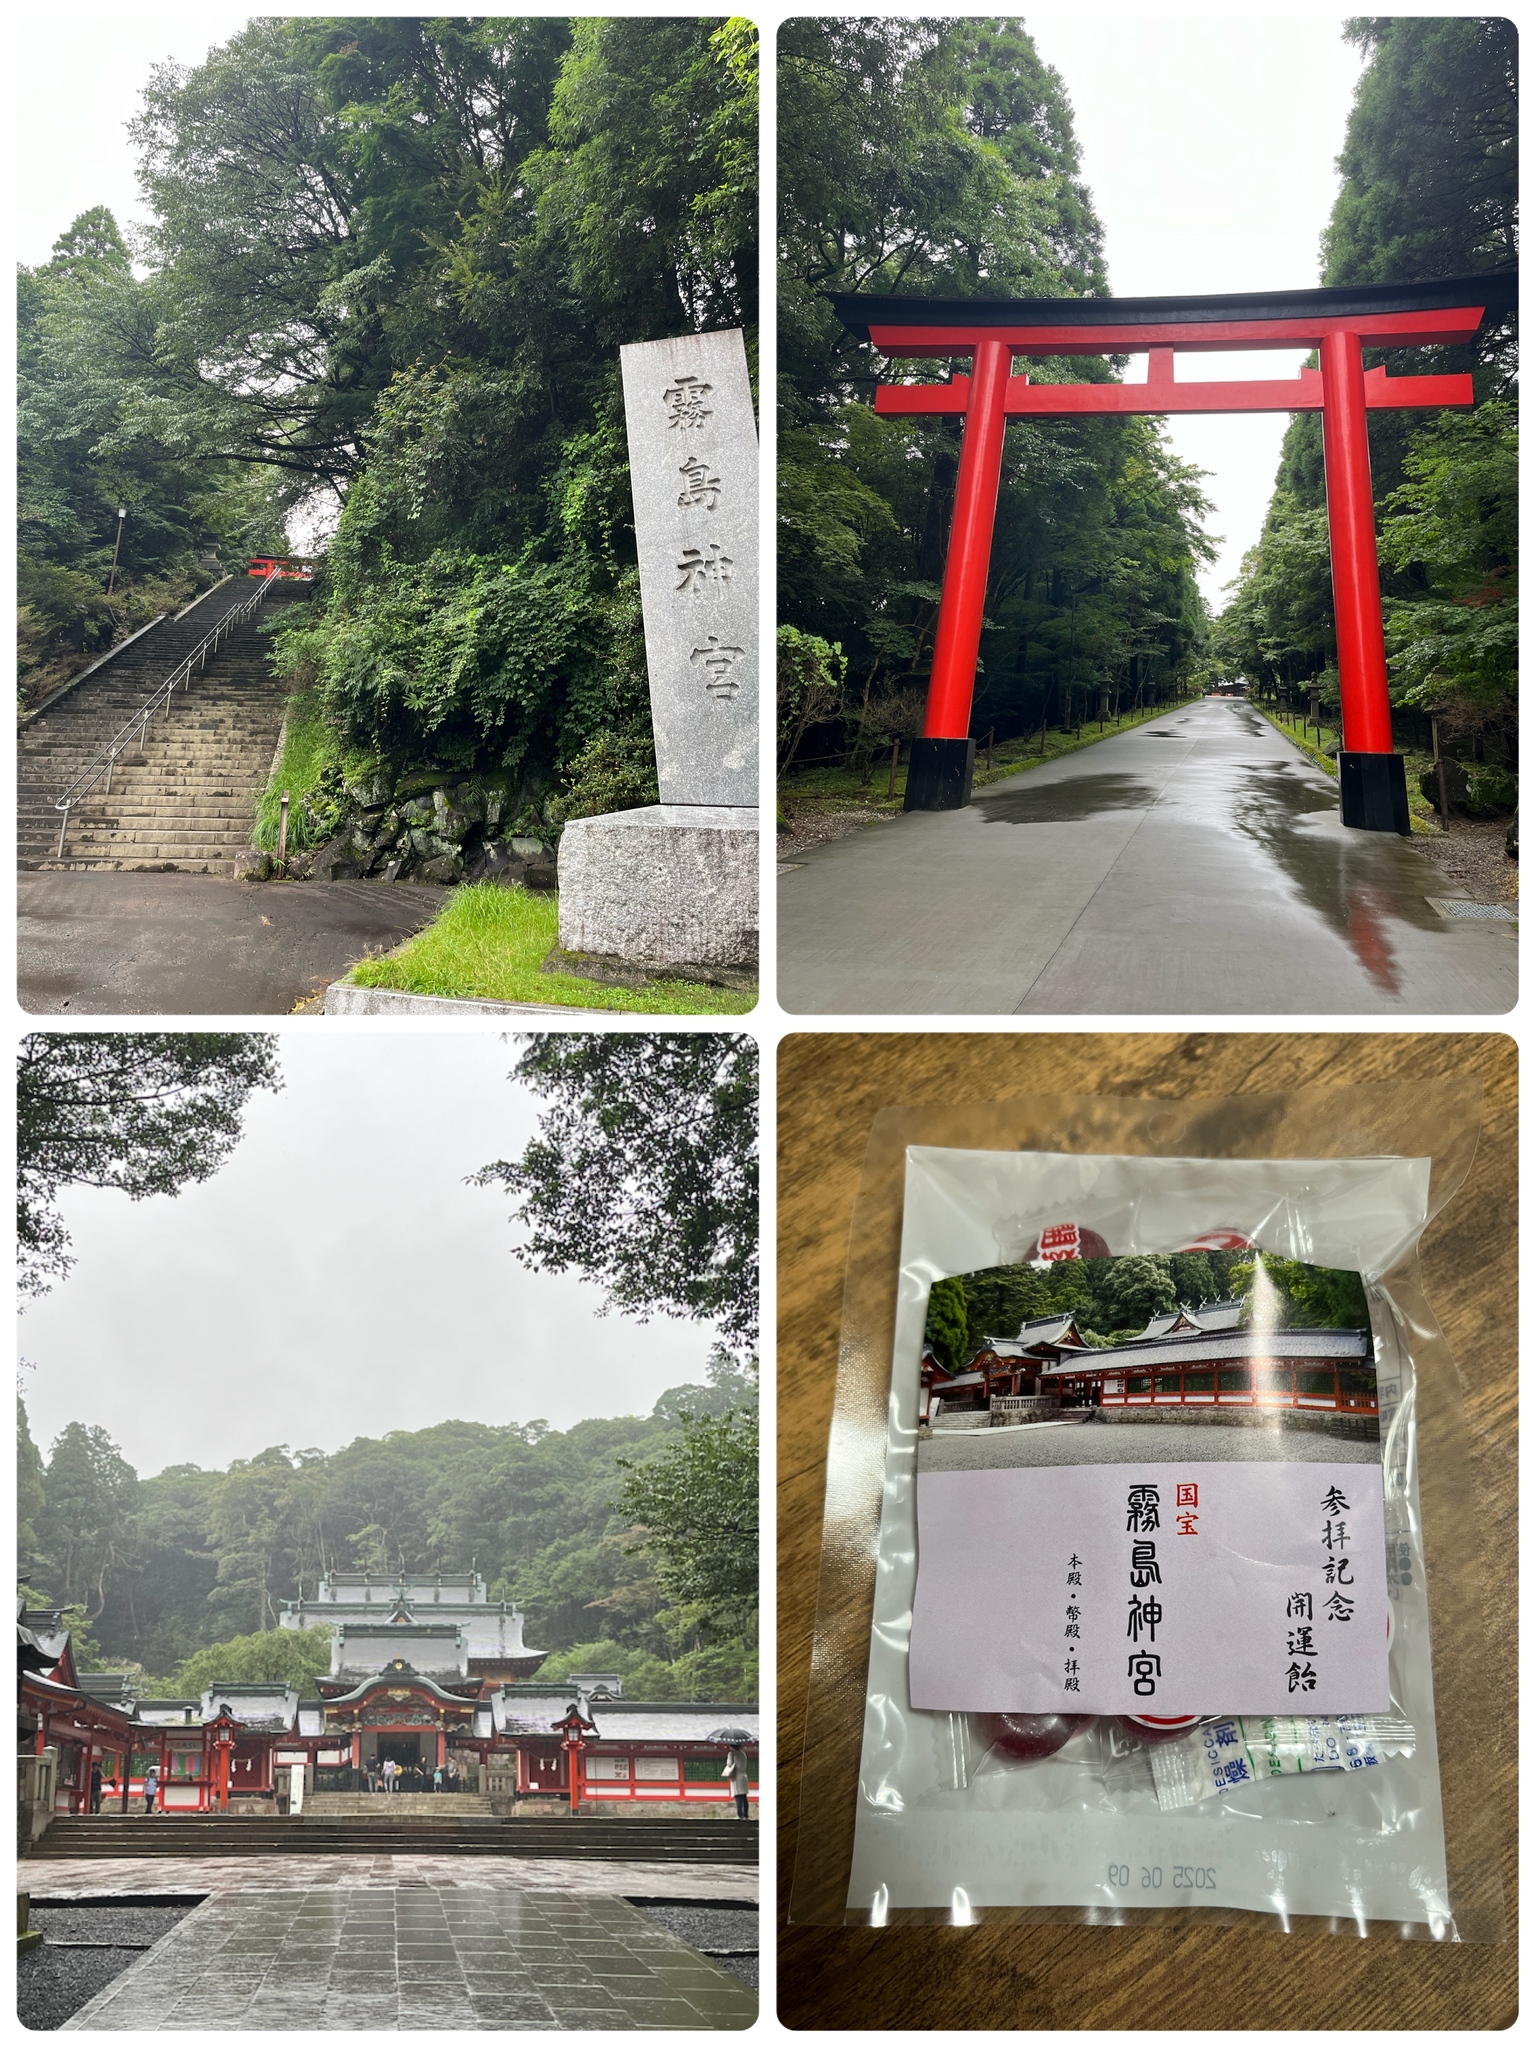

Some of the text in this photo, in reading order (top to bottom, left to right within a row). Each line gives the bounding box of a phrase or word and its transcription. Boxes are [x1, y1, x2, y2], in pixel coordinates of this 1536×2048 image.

[662, 375, 747, 701] 霧島神宮
[1176, 1484, 1199, 1535] 国宝
[1321, 1486, 1354, 1621] 参拝記念
[1127, 1485, 1162, 1696] 霧島神宮
[1285, 1592, 1318, 1693] 開運飴
[1201, 1718, 1229, 1795] DESICCA
